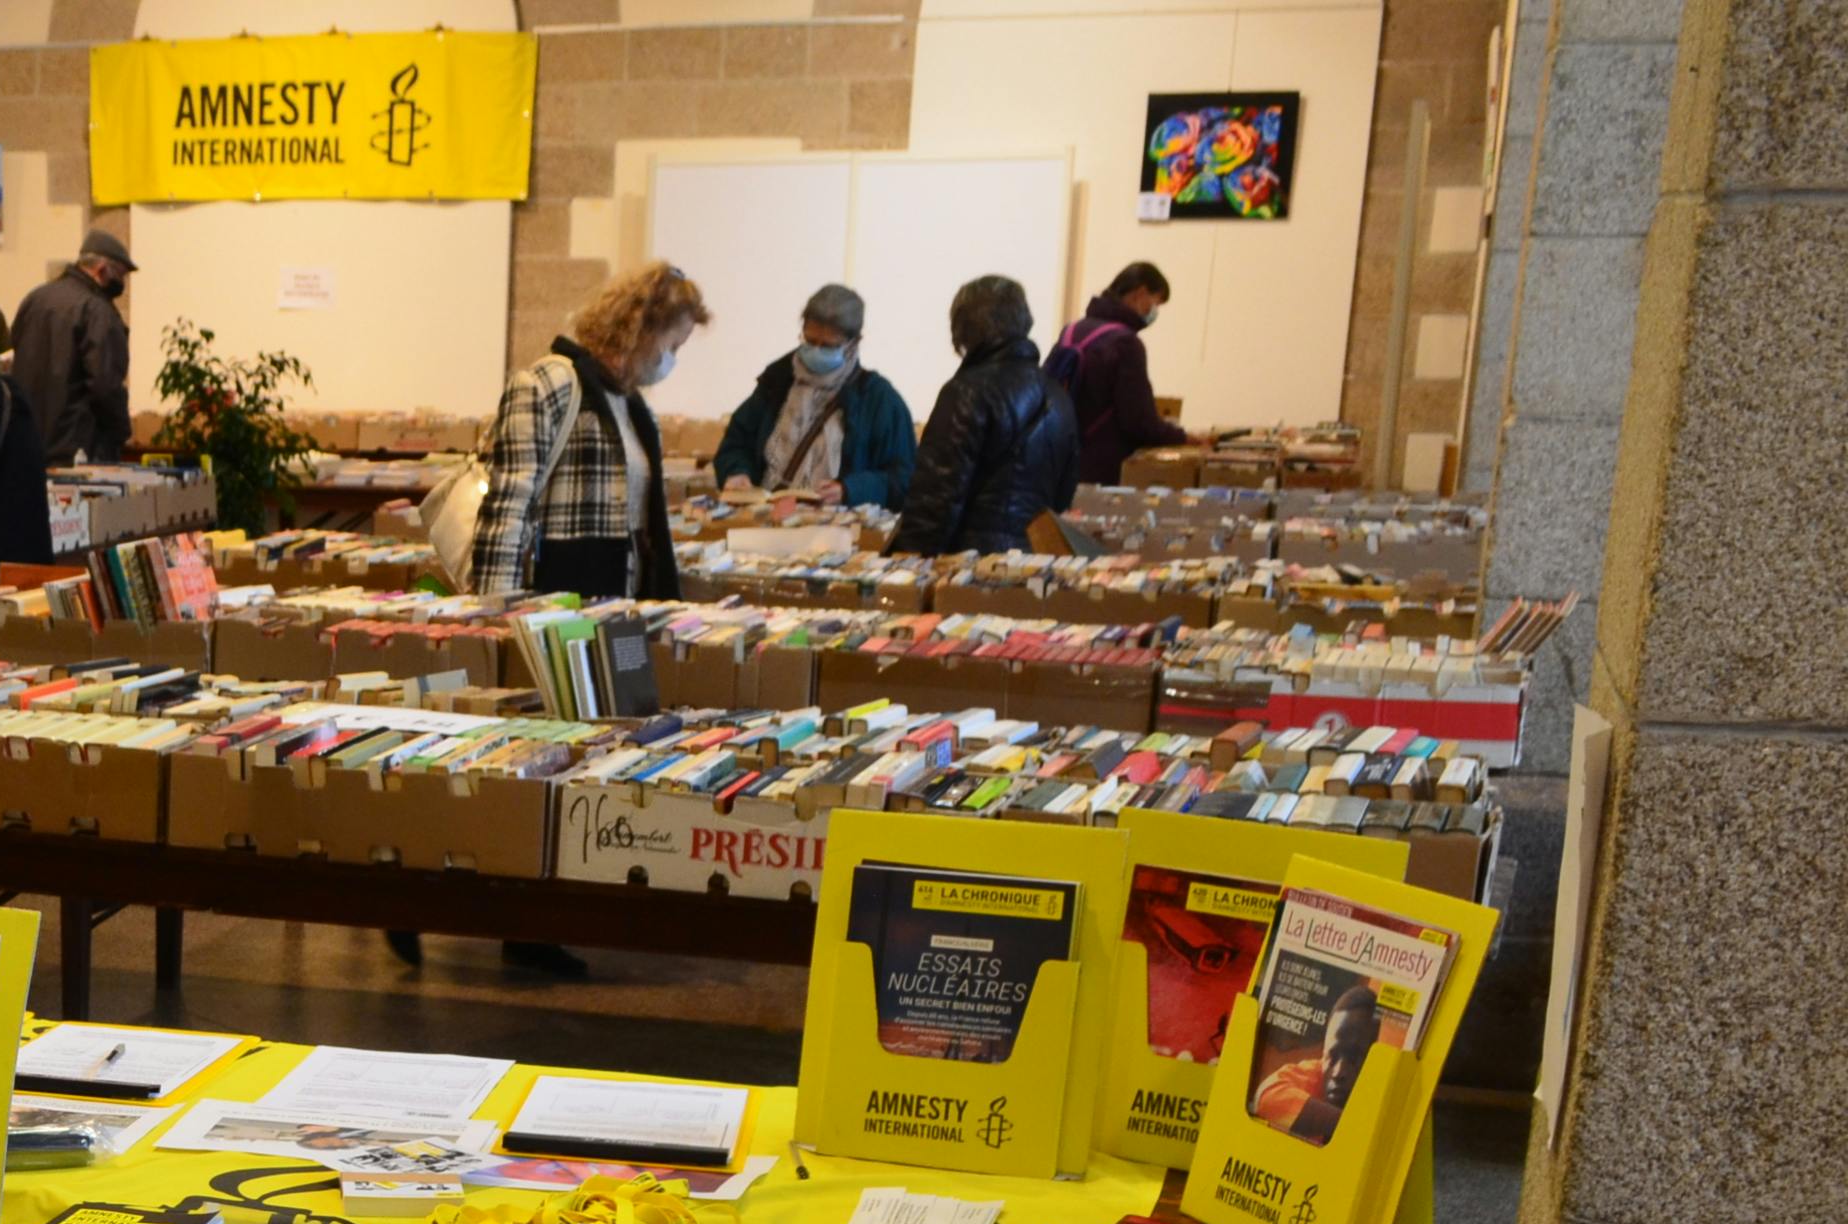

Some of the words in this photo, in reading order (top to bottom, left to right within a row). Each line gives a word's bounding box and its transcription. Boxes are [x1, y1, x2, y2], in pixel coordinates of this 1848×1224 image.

[174, 81, 346, 128] AMNESTY
[172, 136, 346, 166] INTERNATIONAL
[940, 887, 959, 899] LA
[961, 888, 1041, 906] CHRONIQUE
[1213, 890, 1231, 905] LA
[1285, 910, 1305, 942] La
[1305, 918, 1350, 953] Lettre
[1350, 930, 1434, 982] d'Amnesty
[918, 952, 1003, 978] ESSAIS
[888, 972, 1028, 1002] NUCLÉAIRES
[898, 996, 913, 1006] UN
[914, 998, 950, 1009] SECRET
[953, 1001, 975, 1012] BIEN
[976, 1003, 1012, 1015] ENFOUI
[866, 1090, 968, 1123] AMNESTY
[1130, 1089, 1208, 1124] AMNES
[863, 1117, 965, 1144] INTERNATIONAL
[1220, 1156, 1292, 1206] AMNESTY
